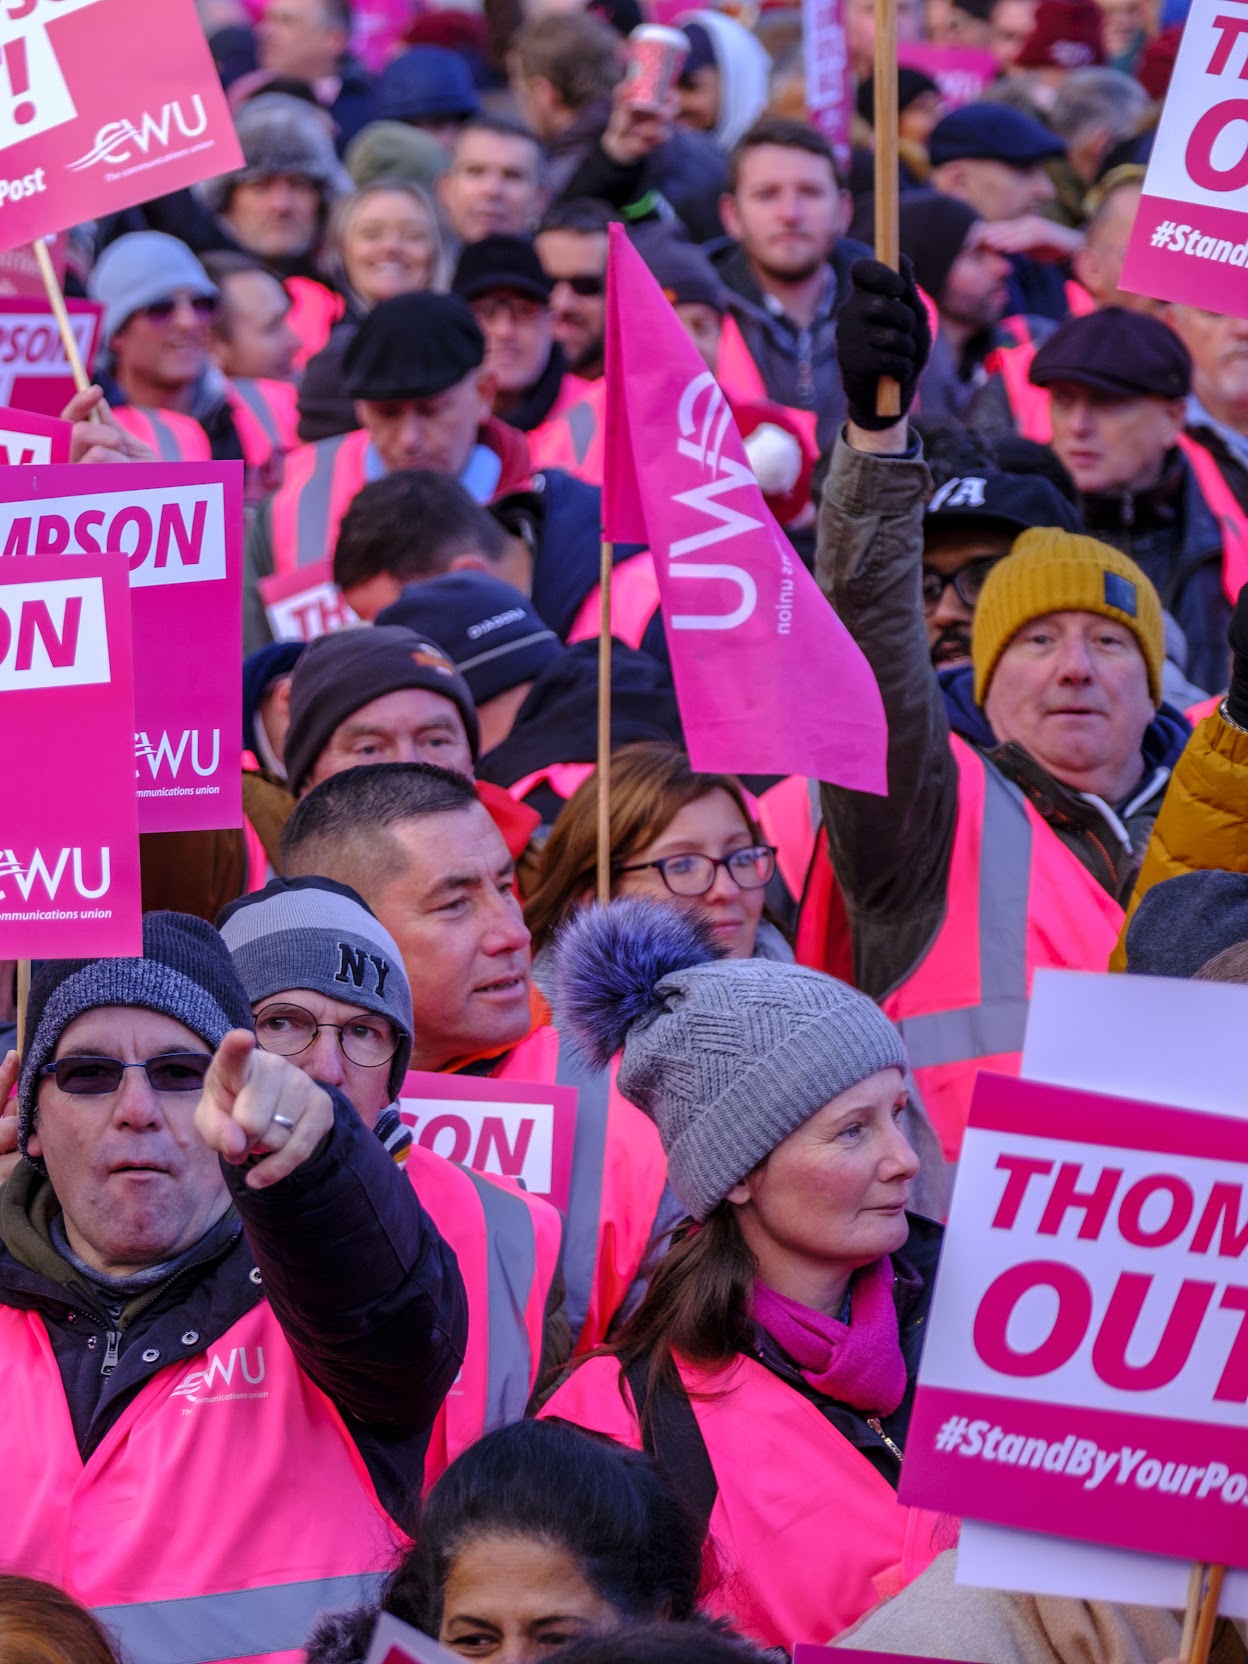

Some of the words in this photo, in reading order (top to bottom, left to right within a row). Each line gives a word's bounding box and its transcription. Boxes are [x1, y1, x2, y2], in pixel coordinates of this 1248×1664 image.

[95, 93, 207, 163] CWU
[136, 728, 220, 780] WU
[196, 784, 220, 795] union
[80, 907, 112, 919] union
[334, 941, 390, 998] NY
[935, 1415, 1248, 1506] #StandByYourPo
